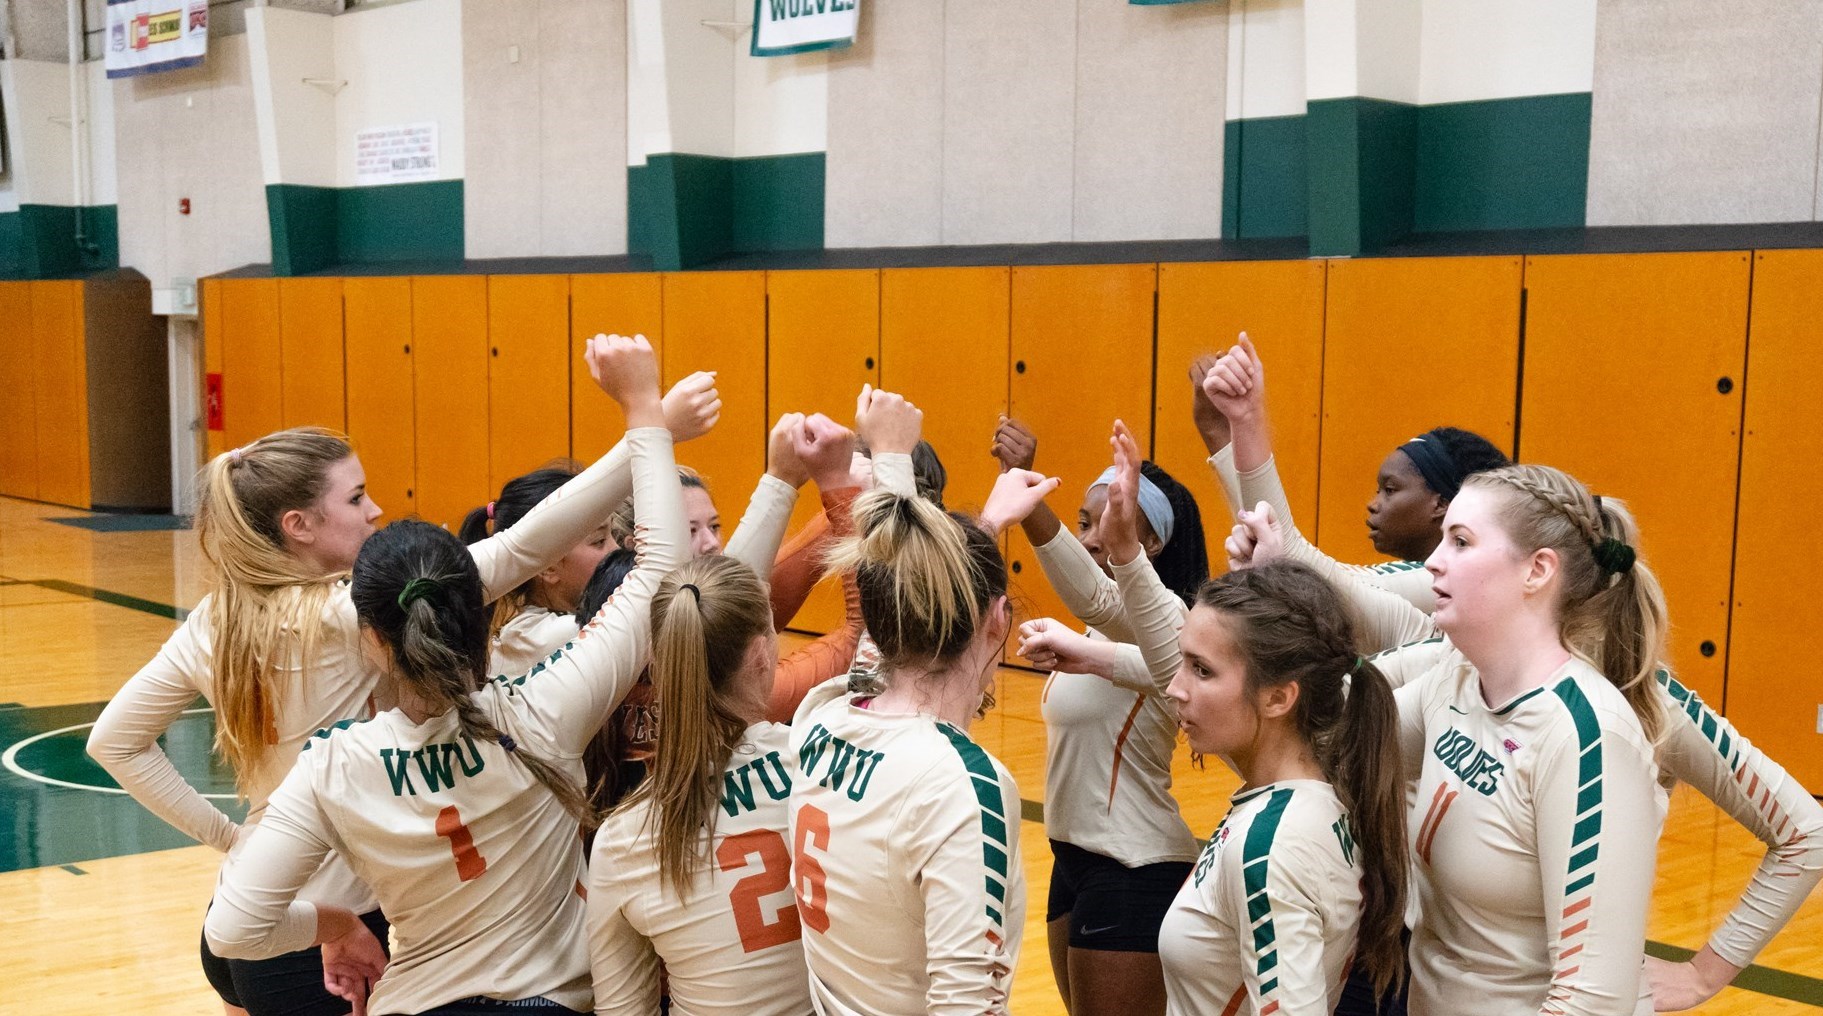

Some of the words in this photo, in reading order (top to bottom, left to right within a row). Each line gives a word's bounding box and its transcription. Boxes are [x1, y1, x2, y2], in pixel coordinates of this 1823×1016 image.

[380, 731, 485, 796] WWU
[718, 751, 792, 818] WU
[799, 723, 885, 802] WWU
[1433, 726, 1505, 796] WOLVES
[435, 804, 487, 882] 1
[794, 803, 831, 934] 6
[715, 828, 802, 953] 2
